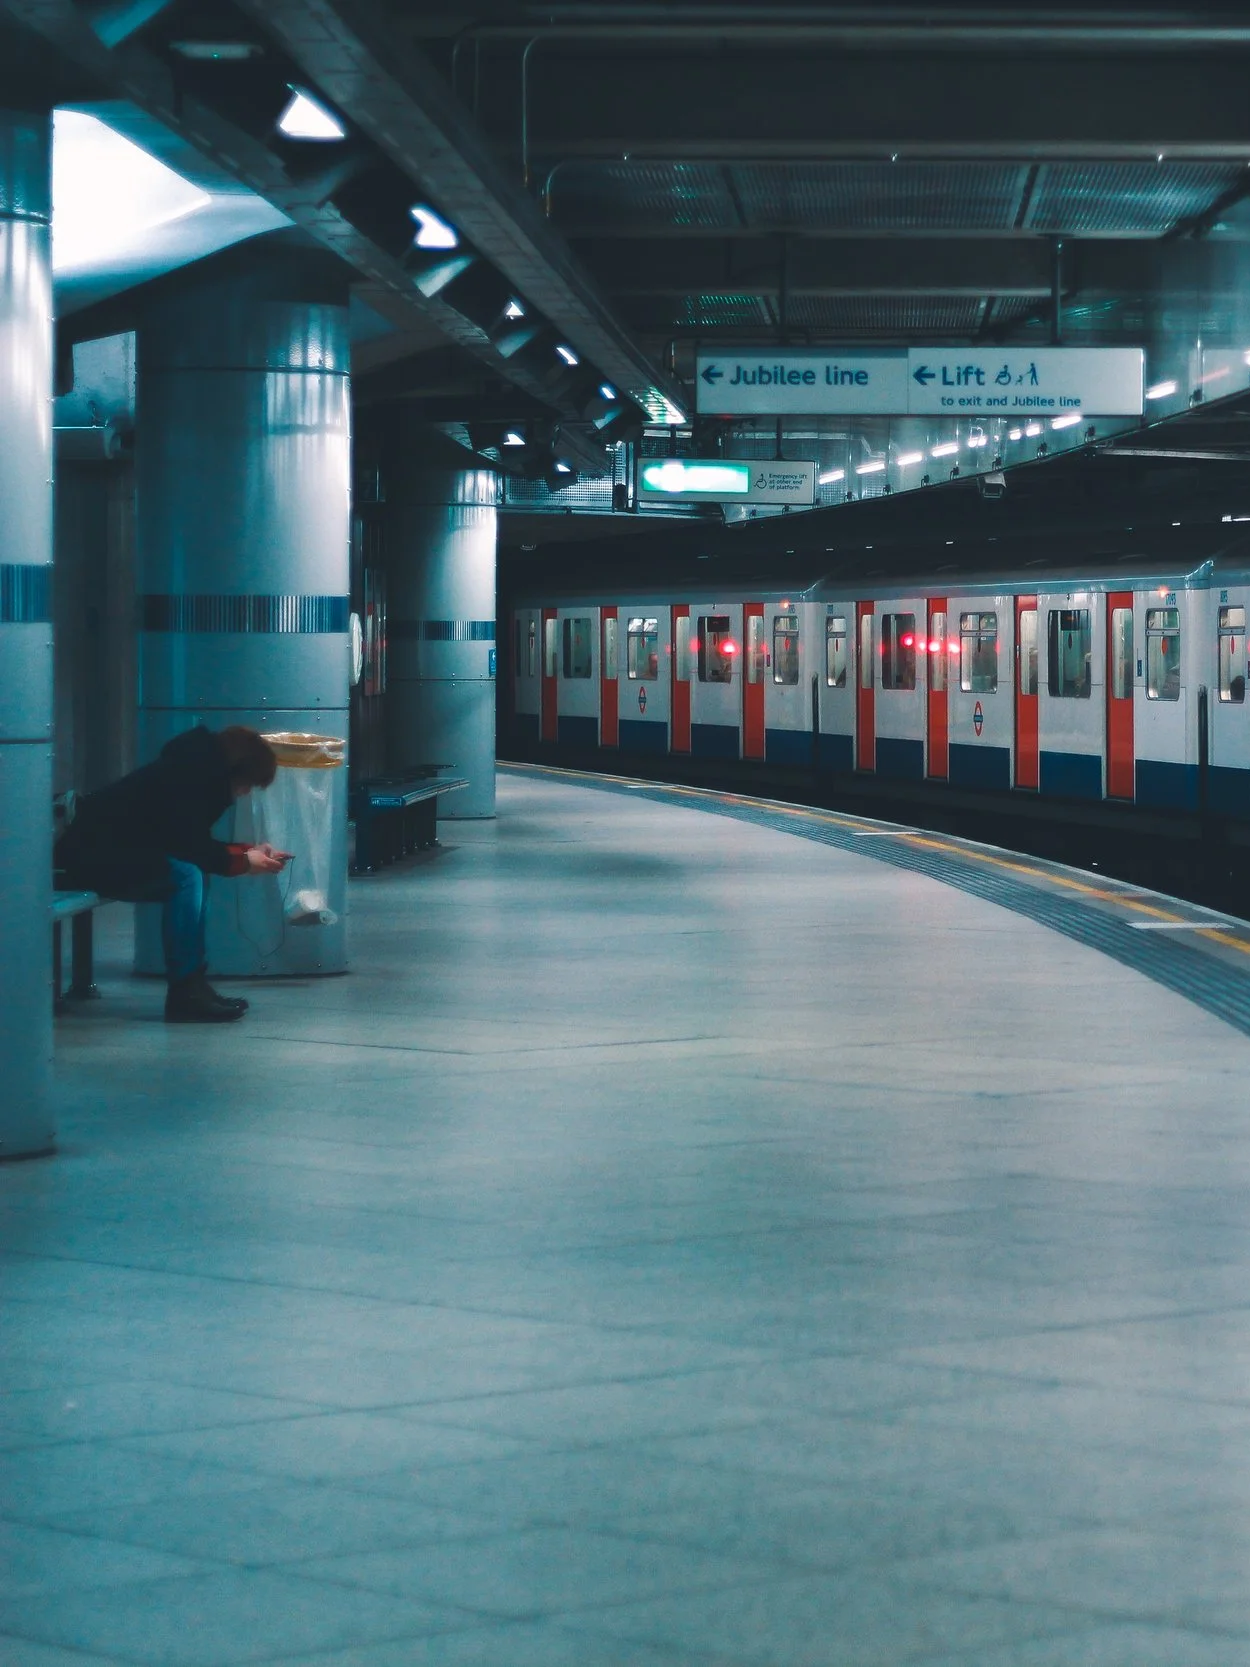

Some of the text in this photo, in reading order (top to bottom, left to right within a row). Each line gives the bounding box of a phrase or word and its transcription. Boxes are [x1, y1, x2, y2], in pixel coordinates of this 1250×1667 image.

[729, 364, 869, 386] Jubilee line
[941, 365, 986, 386] Lift
[941, 396, 1081, 407] to exit and Jubilee line
